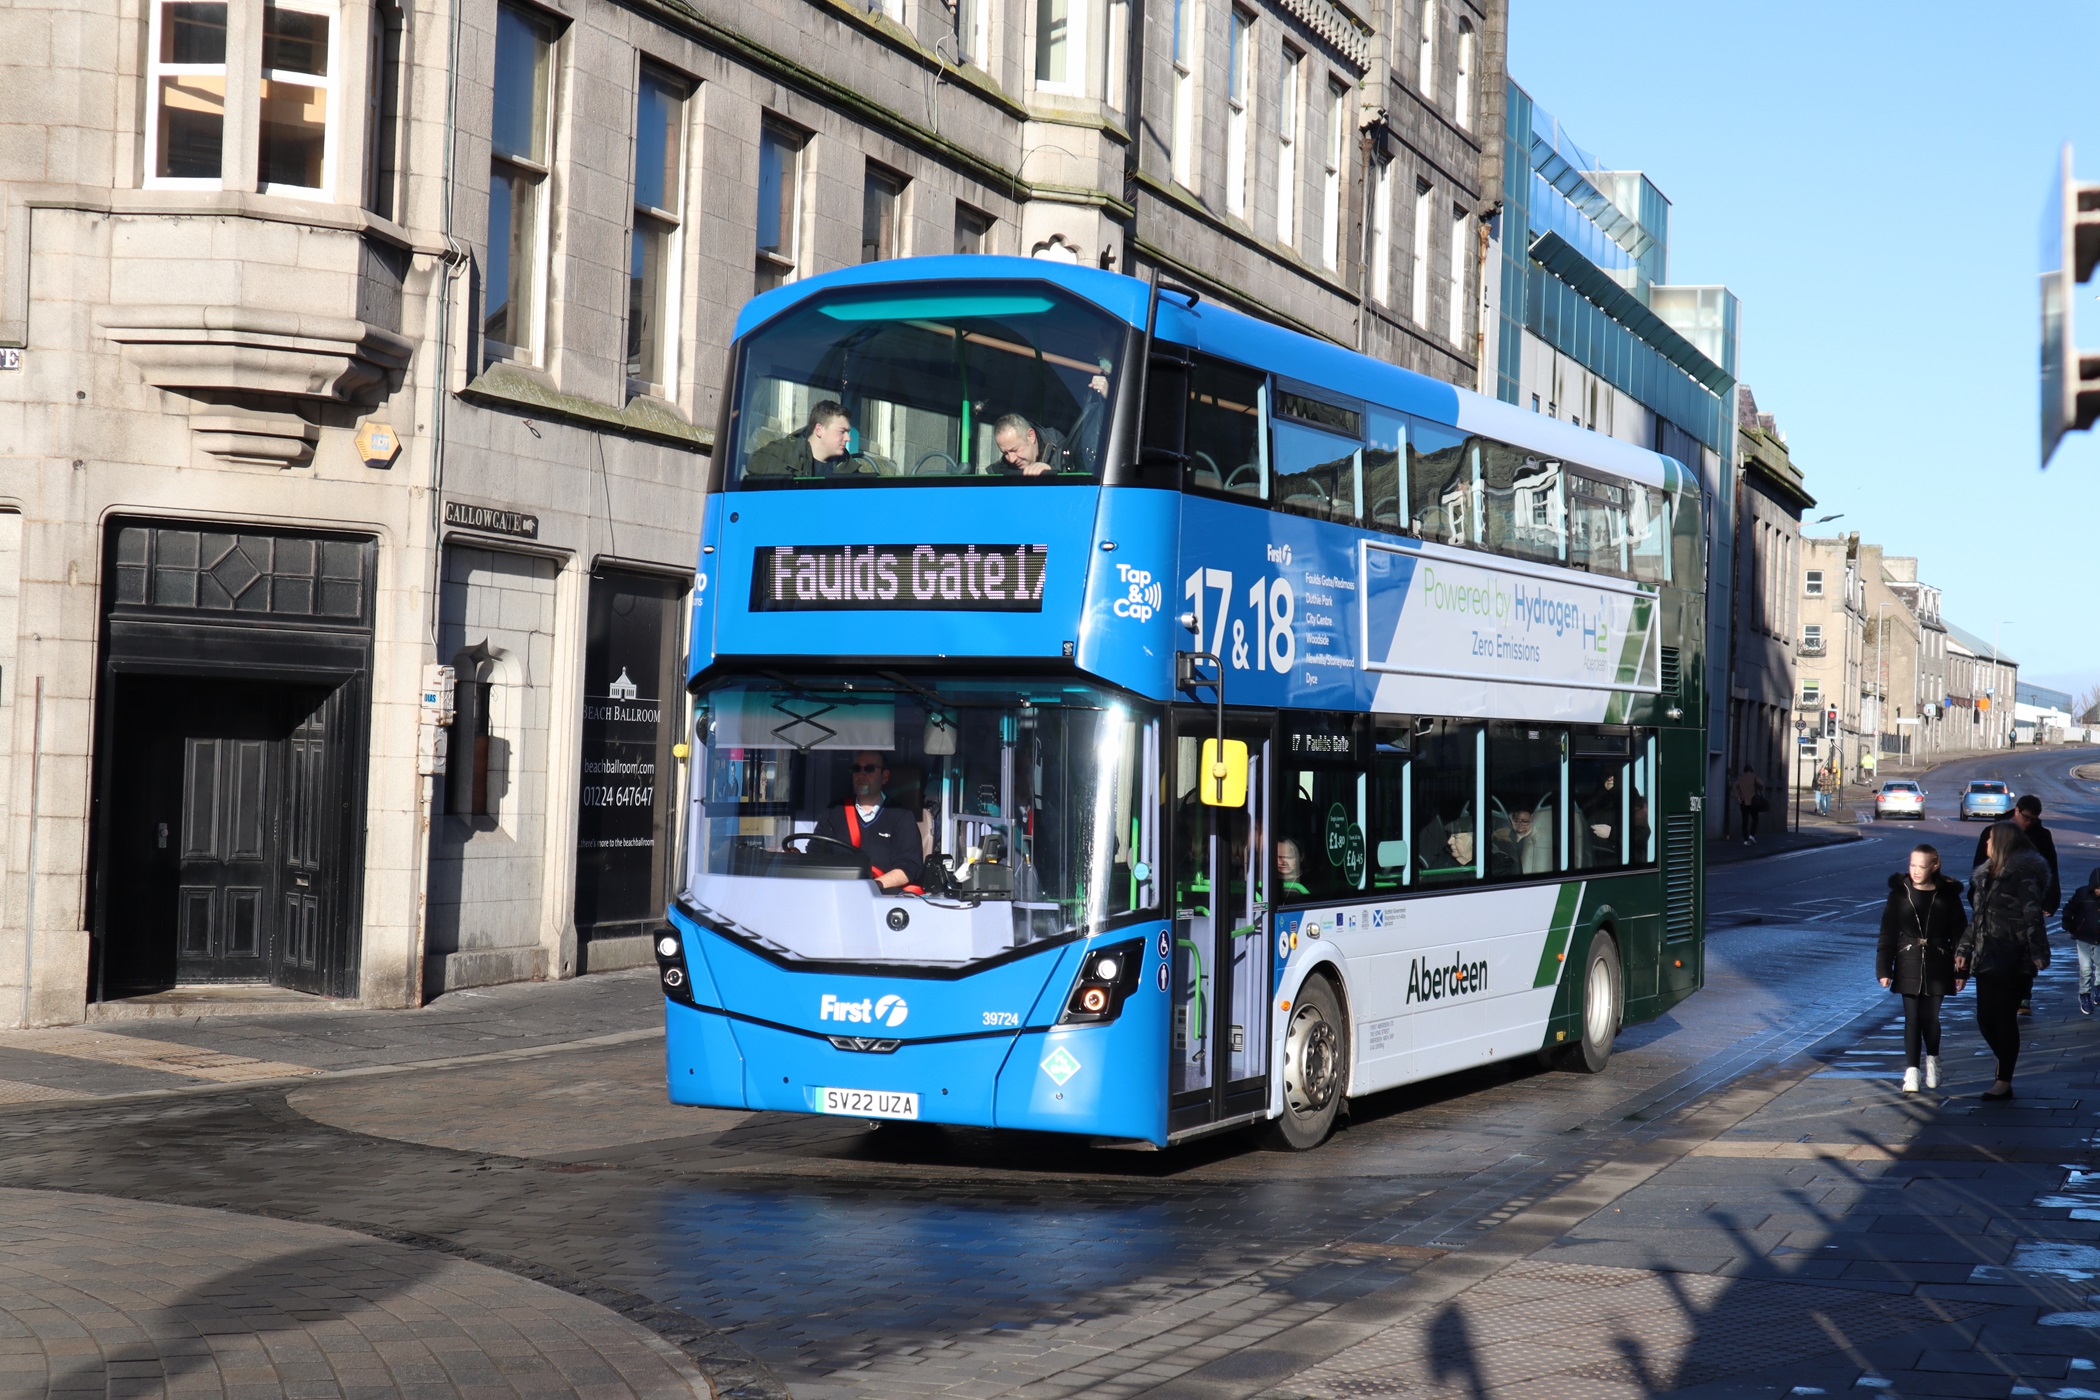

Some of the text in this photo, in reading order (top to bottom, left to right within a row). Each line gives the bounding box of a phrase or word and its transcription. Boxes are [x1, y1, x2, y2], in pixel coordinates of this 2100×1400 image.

[445, 503, 521, 531] GALLOWGATE
[775, 545, 898, 600] Faulds
[912, 545, 1006, 600] Gate
[1116, 563, 1151, 588] Tap
[1128, 584, 1144, 604] &
[1322, 594, 1333, 606] Park
[1424, 567, 1579, 637] Powered by Hydrogen
[1113, 598, 1152, 623] Cap
[1185, 566, 1295, 674] 17 & 18
[1306, 612, 1333, 627] City Centre
[1472, 630, 1540, 663] Zero Emissions
[1583, 654, 1608, 672] Aberdeen
[1306, 672, 1318, 686] Dyce
[583, 704, 661, 723] BEACH BALLROOM
[584, 758, 654, 775] beachballroom.com
[583, 786, 654, 807] 01224 647647
[597, 839, 609, 847] more
[609, 838, 614, 847] to
[623, 837, 654, 847] beachballroom
[1406, 951, 1487, 1005] Aberdeen
[820, 994, 872, 1023] First
[982, 1012, 1019, 1026] 39724
[828, 1091, 913, 1114] SV22 UZA
